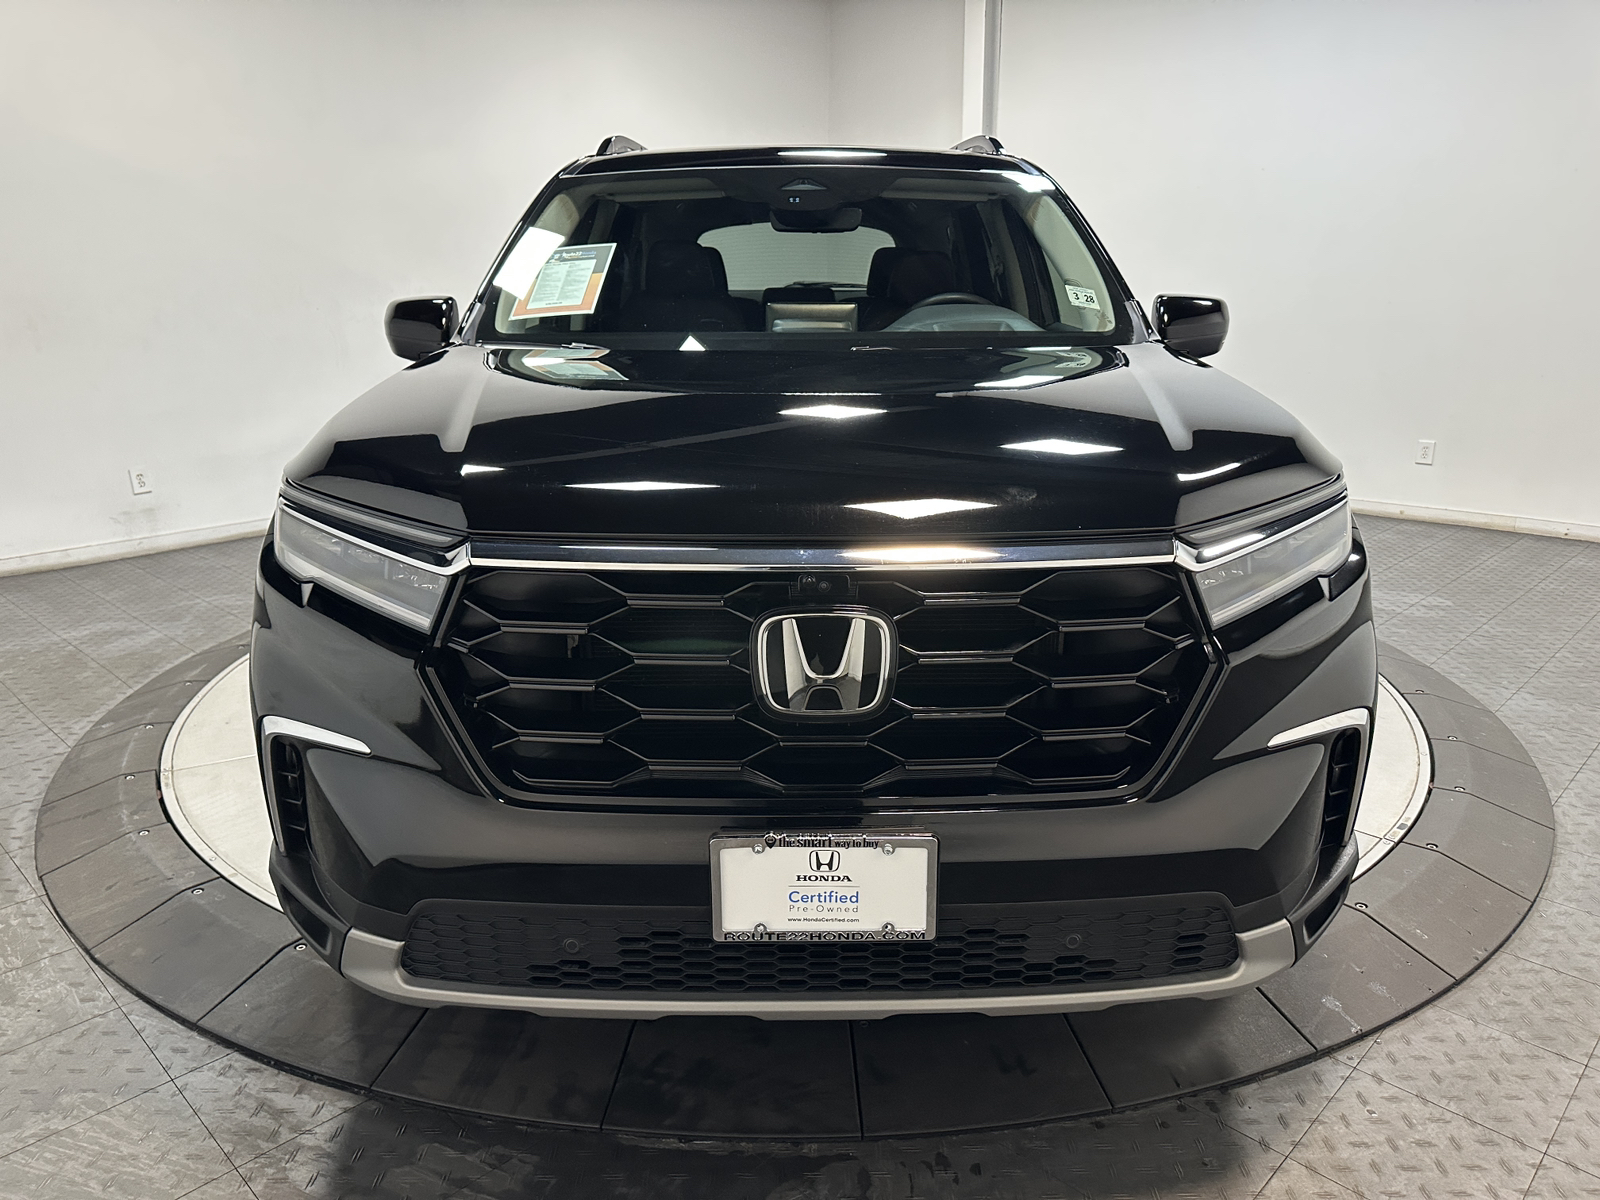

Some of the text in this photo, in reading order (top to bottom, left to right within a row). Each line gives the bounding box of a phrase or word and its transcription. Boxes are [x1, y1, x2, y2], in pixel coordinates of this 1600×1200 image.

[1072, 292, 1080, 300] 3
[1083, 294, 1096, 304] 28
[779, 836, 880, 850] the smart way to buy
[796, 874, 853, 882] HONDA
[788, 890, 859, 904] Certified
[789, 904, 859, 913] Pre-Owned
[723, 931, 926, 941] ROUTE22HONDA.COM
